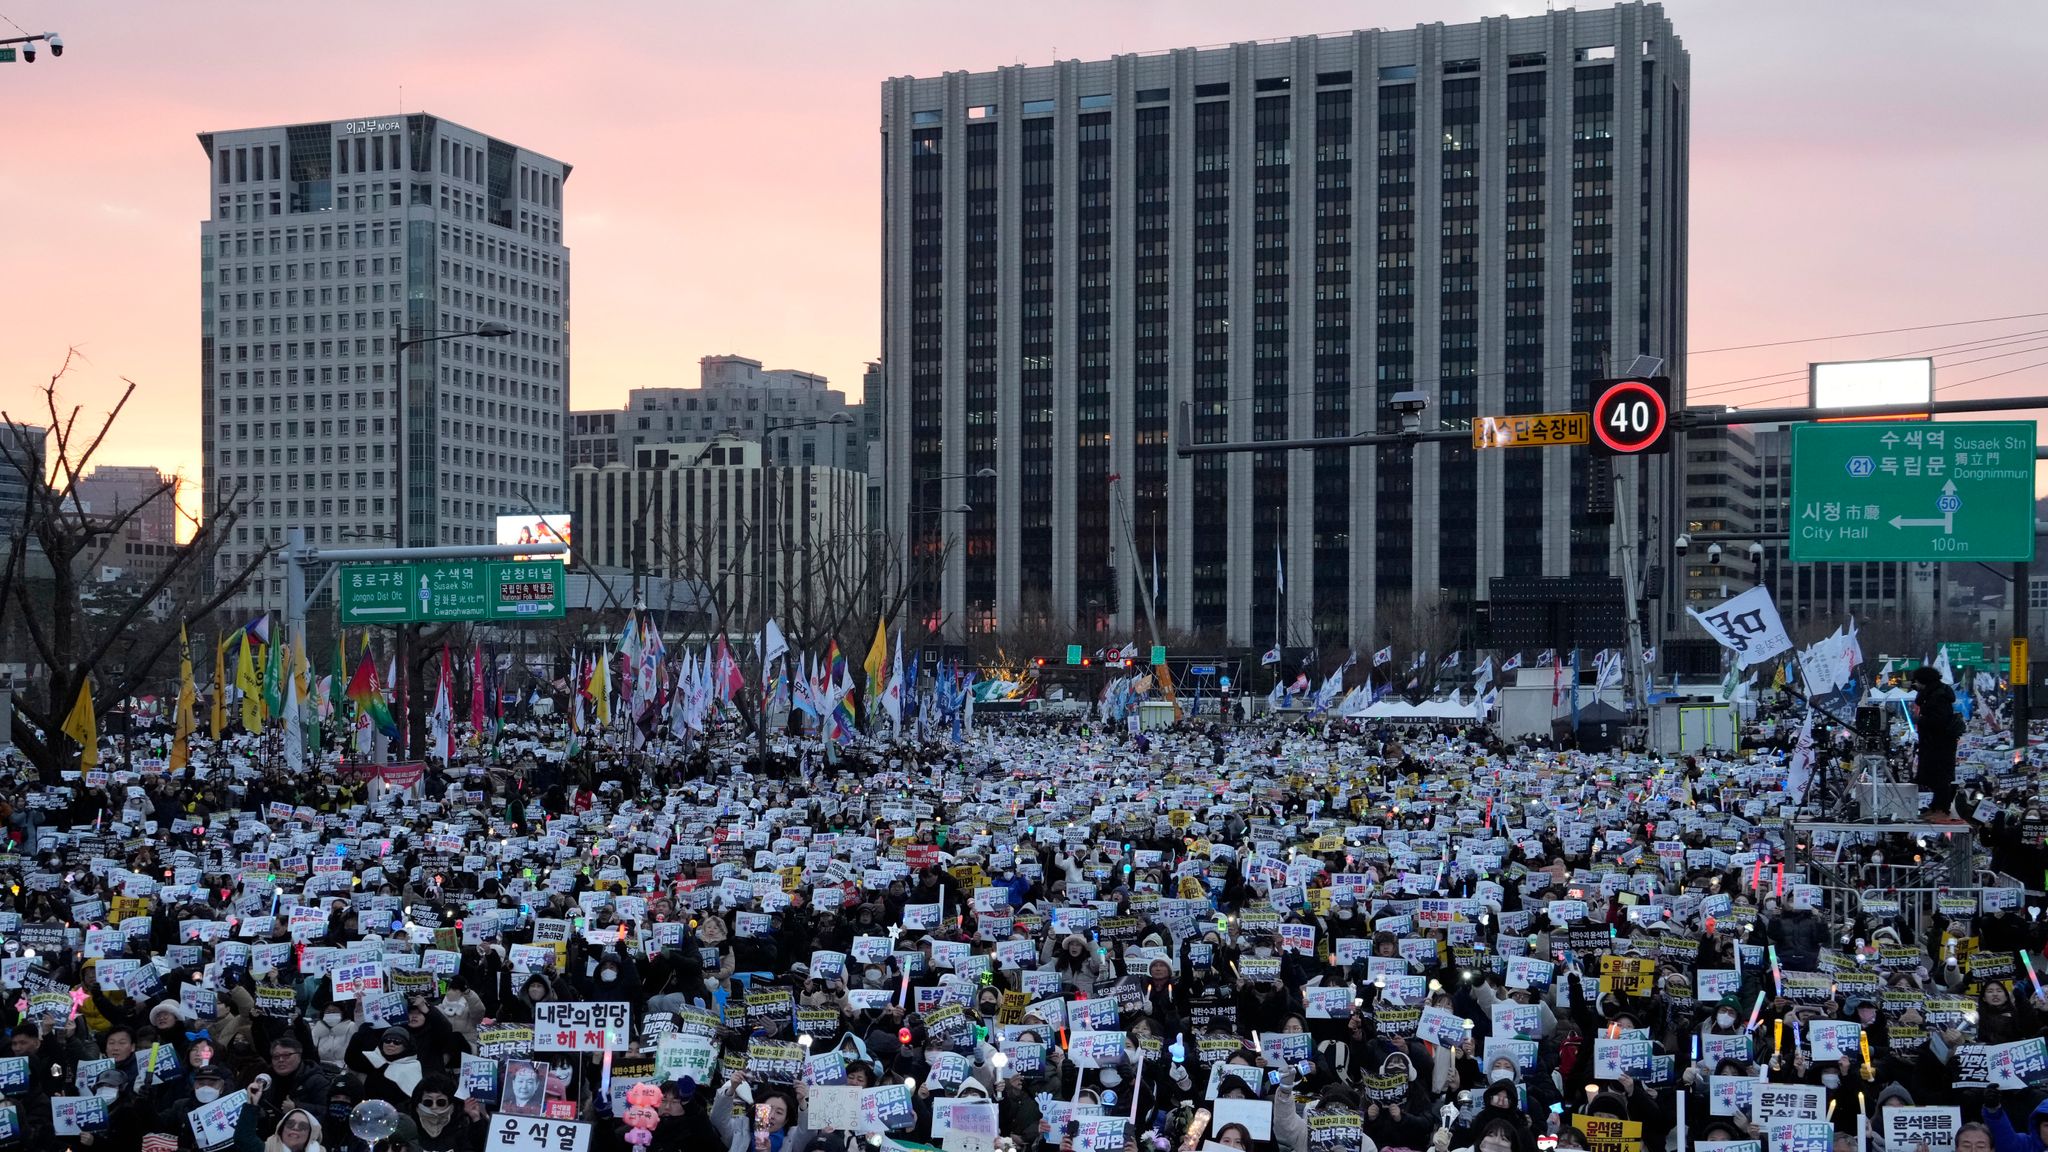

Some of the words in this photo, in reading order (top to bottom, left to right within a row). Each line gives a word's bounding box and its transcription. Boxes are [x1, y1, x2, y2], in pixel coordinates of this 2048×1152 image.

[347, 120, 376, 134] 외교부
[1611, 402, 1648, 433] 40
[1880, 430, 1945, 450] 수색역
[1954, 437, 2000, 450] Susaek
[2005, 437, 2025, 449] Stn
[1853, 460, 1868, 473] 21
[1880, 456, 1945, 476] 독립문
[1956, 453, 1999, 466] 獨立門
[1954, 468, 2028, 479] Dongnimmun
[1942, 498, 1956, 509] 50
[1802, 503, 1840, 521] 시청
[1847, 505, 1879, 520] 市廳
[1802, 527, 1833, 541] City
[1840, 527, 1867, 539] Hall
[1932, 539, 1968, 551] 100m
[352, 573, 403, 587] 종로구청
[434, 568, 473, 580] 수색역
[501, 568, 551, 580] 삼청터널
[434, 581, 458, 590] Susaek
[462, 581, 472, 589] Stn
[502, 584, 528, 593] 국립민속
[533, 584, 553, 592] 박물관
[352, 593, 374, 602] Jongno
[434, 594, 456, 606] 광화문
[434, 608, 484, 616] Gwanghwamun
[340, 965, 376, 981] 윤석열
[1117, 984, 1136, 992] 모이자
[1611, 976, 1638, 991] 파면
[1121, 992, 1141, 1001] 모이자
[747, 1002, 790, 1018] 체포!구속!
[1090, 1001, 1114, 1016] 체포!
[1218, 1006, 1236, 1015] 윤석열
[1514, 1007, 1537, 1019] 체포!
[538, 1003, 627, 1028] 내란의힘당
[798, 1021, 837, 1030] 체포!구속!
[1092, 1017, 1114, 1029] 구속!
[1514, 1020, 1537, 1029] 구속!
[510, 1031, 529, 1039] 윤석열
[1094, 1034, 1119, 1046] 체포!
[1283, 1035, 1307, 1048] 체포!
[480, 1041, 533, 1057] 체포!구속!
[1016, 1045, 1040, 1056] 해체
[1092, 1046, 1120, 1058] 구속!
[1284, 1048, 1308, 1060] 구속!
[1620, 1043, 1648, 1055] 체포!
[2010, 1041, 2041, 1060] 체포!
[747, 1059, 801, 1072] 체포!구속!
[1016, 1058, 1040, 1071] 하라
[1620, 1057, 1648, 1071] 구속!
[2015, 1055, 2045, 1076] 구속!
[876, 1086, 906, 1104] 체포!
[879, 1101, 908, 1120] 구속!
[1587, 1121, 1623, 1137] 윤석열
[1893, 1116, 1952, 1129] 윤석열을
[499, 1119, 577, 1148] 윤석열
[1311, 1128, 1361, 1141] 체포!구속!
[1794, 1125, 1827, 1138] 체포!
[1096, 1136, 1123, 1150] 파면
[1893, 1133, 1952, 1145] 구속하라
